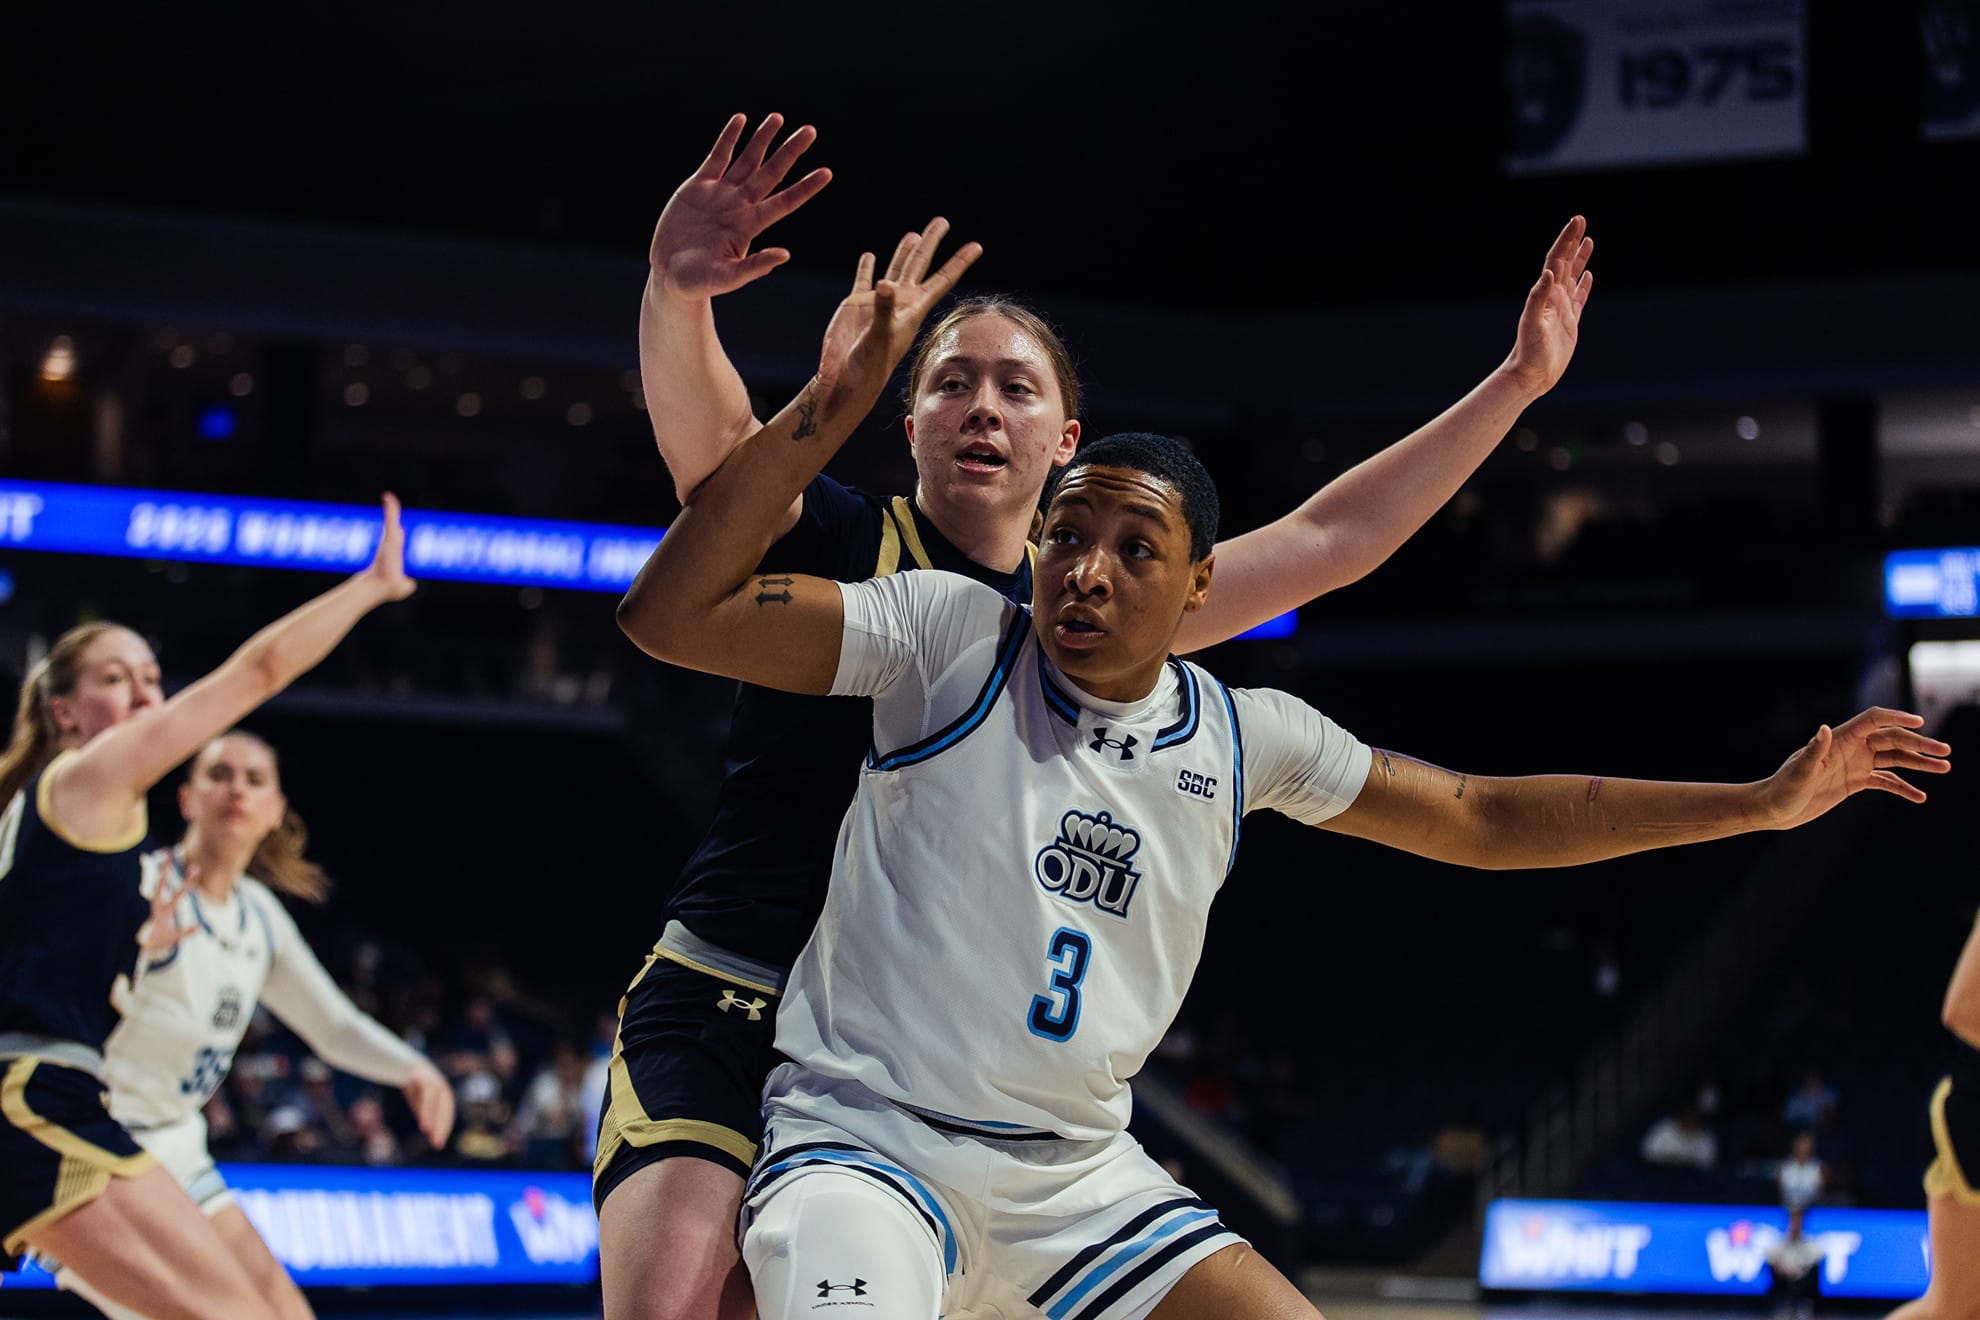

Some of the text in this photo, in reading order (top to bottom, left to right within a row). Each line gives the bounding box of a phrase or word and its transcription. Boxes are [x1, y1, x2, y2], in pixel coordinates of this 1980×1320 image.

[1618, 41, 1796, 108] 1975
[1178, 769, 1218, 799] SBC
[1036, 846, 1141, 918] ODU
[1027, 927, 1092, 1043] 3
